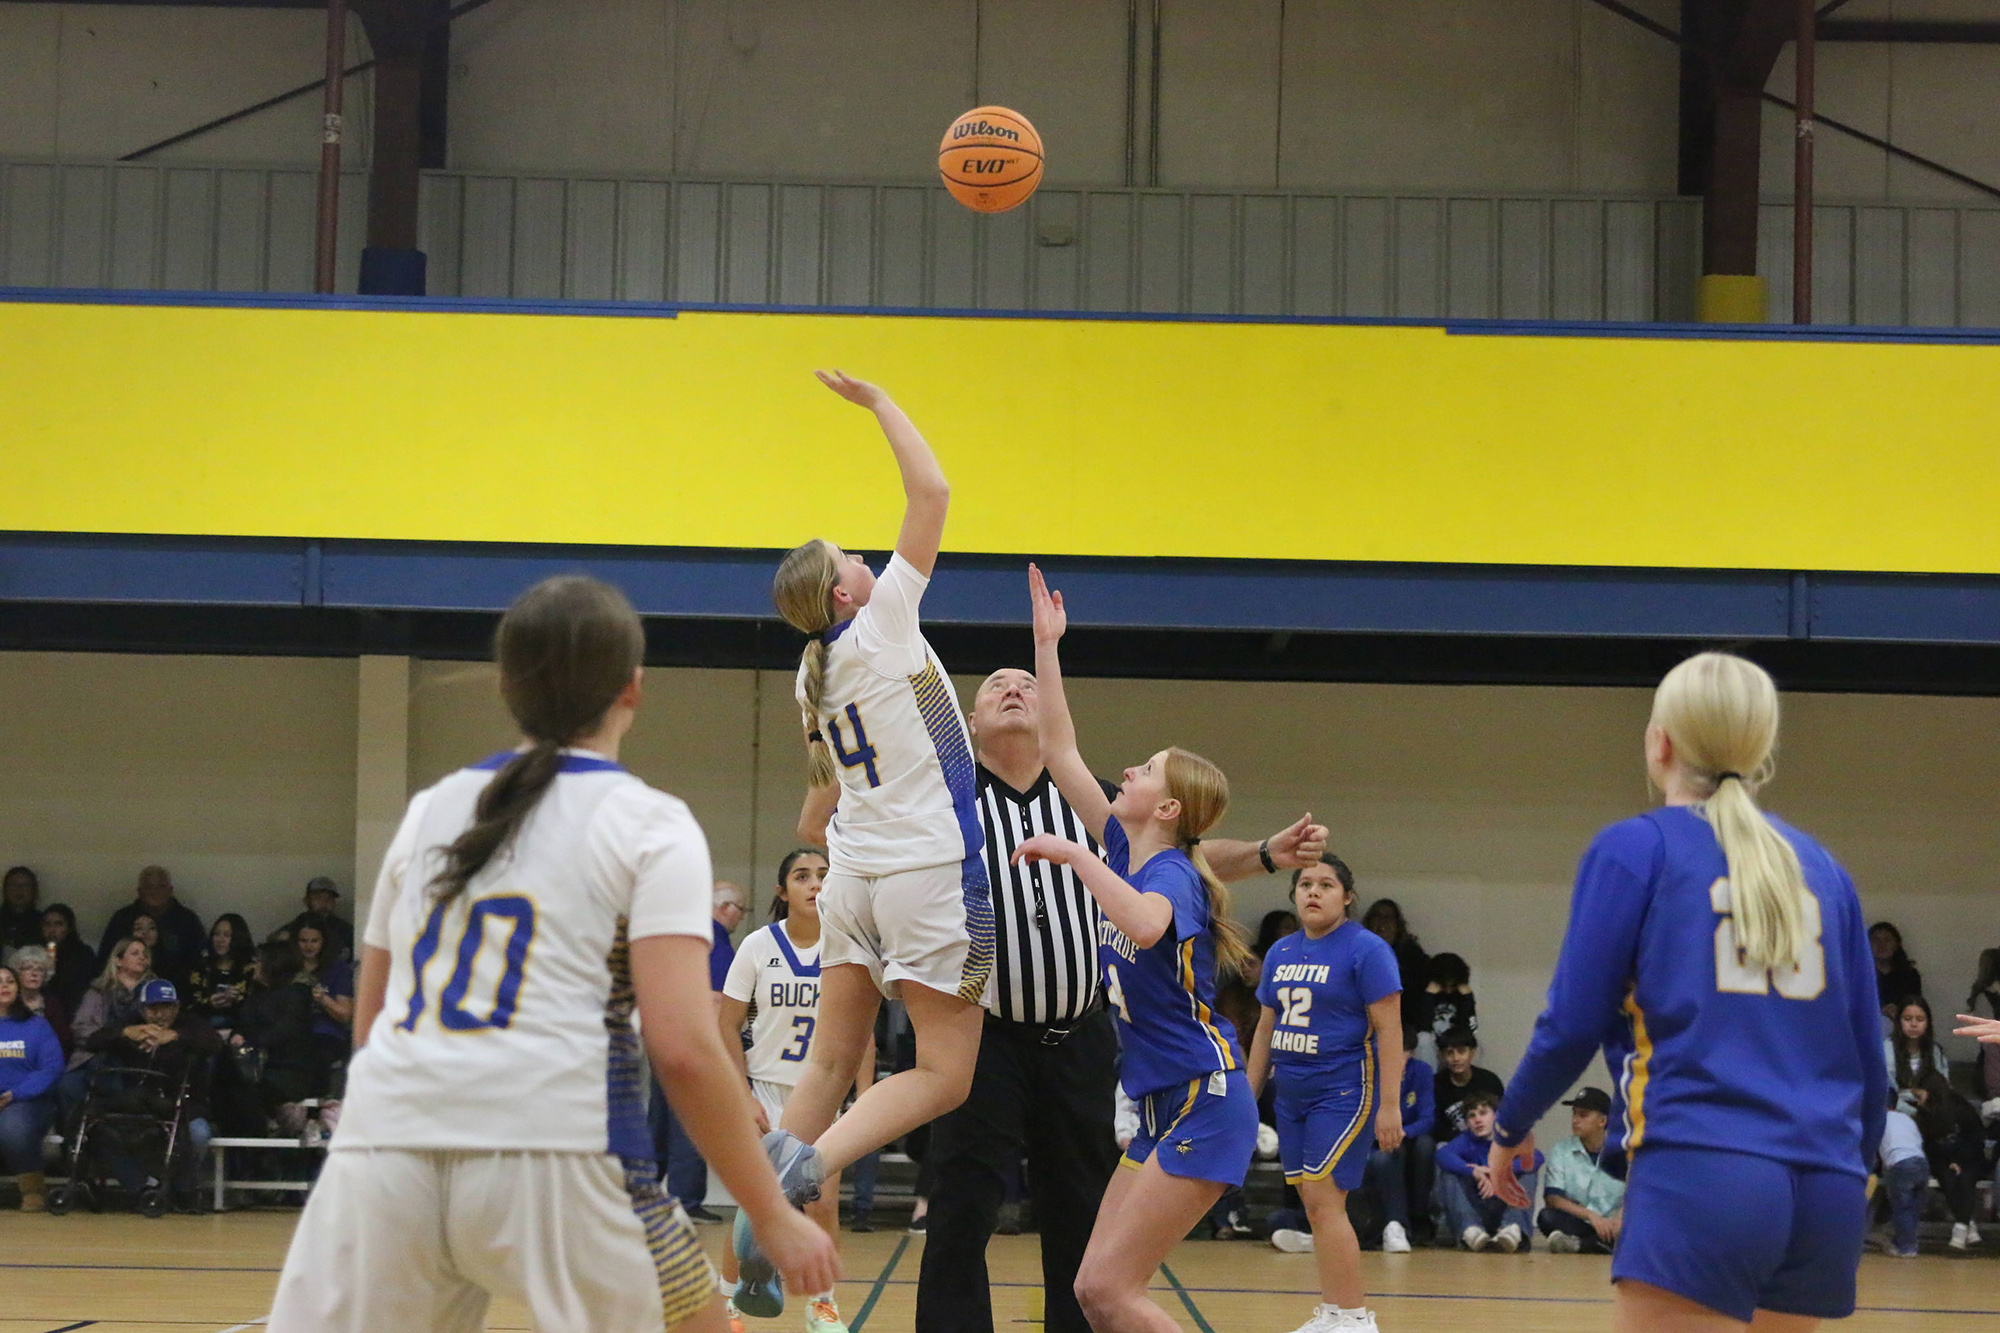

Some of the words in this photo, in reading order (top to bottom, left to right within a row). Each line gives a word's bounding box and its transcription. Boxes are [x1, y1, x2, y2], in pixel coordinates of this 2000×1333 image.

[953, 121, 1019, 142] Wilson
[962, 159, 1005, 173] EVO
[827, 701, 882, 789] 4
[393, 891, 538, 1034] 10
[1272, 964, 1330, 984] SOUTH
[1276, 987, 1312, 1028] 12
[780, 1015, 816, 1062] 3
